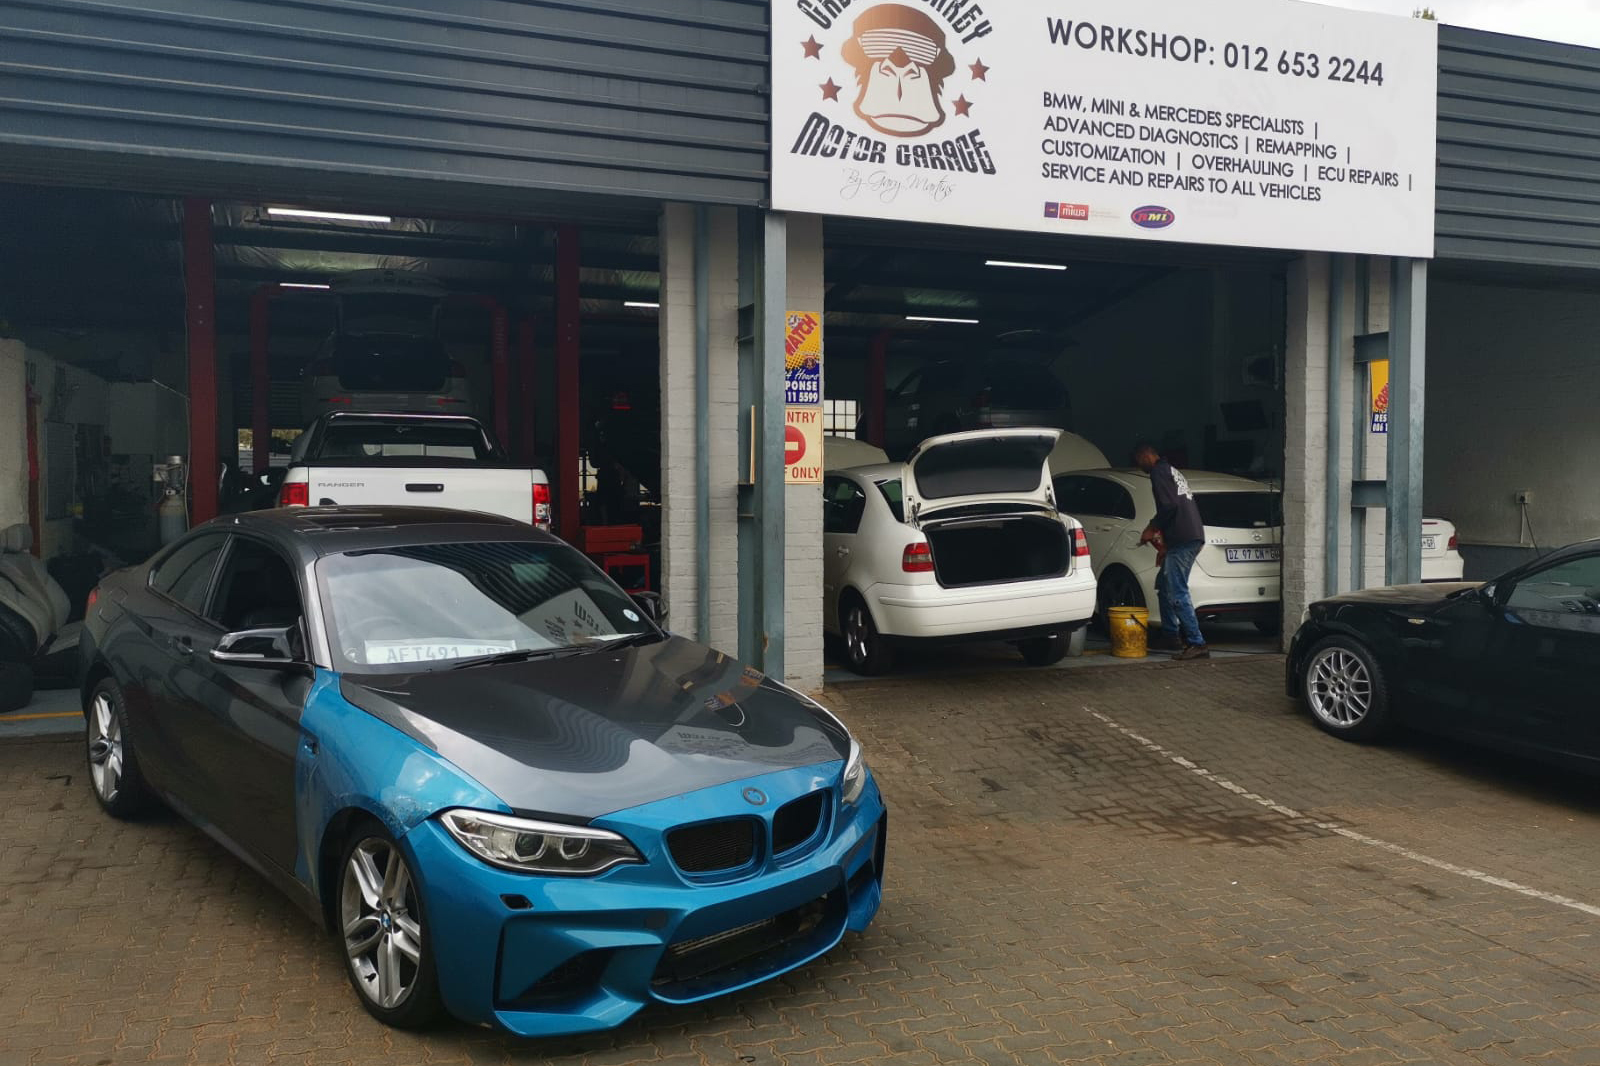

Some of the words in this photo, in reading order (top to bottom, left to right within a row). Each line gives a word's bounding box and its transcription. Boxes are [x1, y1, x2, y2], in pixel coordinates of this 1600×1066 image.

[1047, 17, 1215, 66] WORKSHOP:
[1224, 42, 1269, 72] 012
[1278, 50, 1320, 78] 653
[1328, 57, 1384, 87] 2244
[1044, 91, 1087, 113] BMW,
[1091, 98, 1125, 116] MINI
[1129, 102, 1140, 118] &
[1145, 104, 1222, 127] MERCEDES
[1226, 113, 1304, 136] SPECIALISTS
[790, 112, 887, 164] MOTOR
[896, 128, 996, 175] GARAGE
[1043, 115, 1135, 139] ADVANCED
[1139, 126, 1238, 150] DIAGNOSTICS
[1256, 138, 1337, 159] REMAPPING
[1042, 139, 1166, 166] CUSTOMIZATION
[1192, 154, 1294, 177] OVERHAULING
[1318, 166, 1345, 182] ECU
[1349, 169, 1399, 187] REPAIRS
[1042, 162, 1106, 183] SERVICE
[1109, 168, 1144, 187] AND
[1148, 173, 1205, 192] REPAIRS
[1208, 178, 1228, 194] TO
[1231, 180, 1256, 196] ALL
[1259, 183, 1321, 201] VEHICLES
[787, 411, 817, 423] NTRY
[792, 466, 820, 479] ONLY
